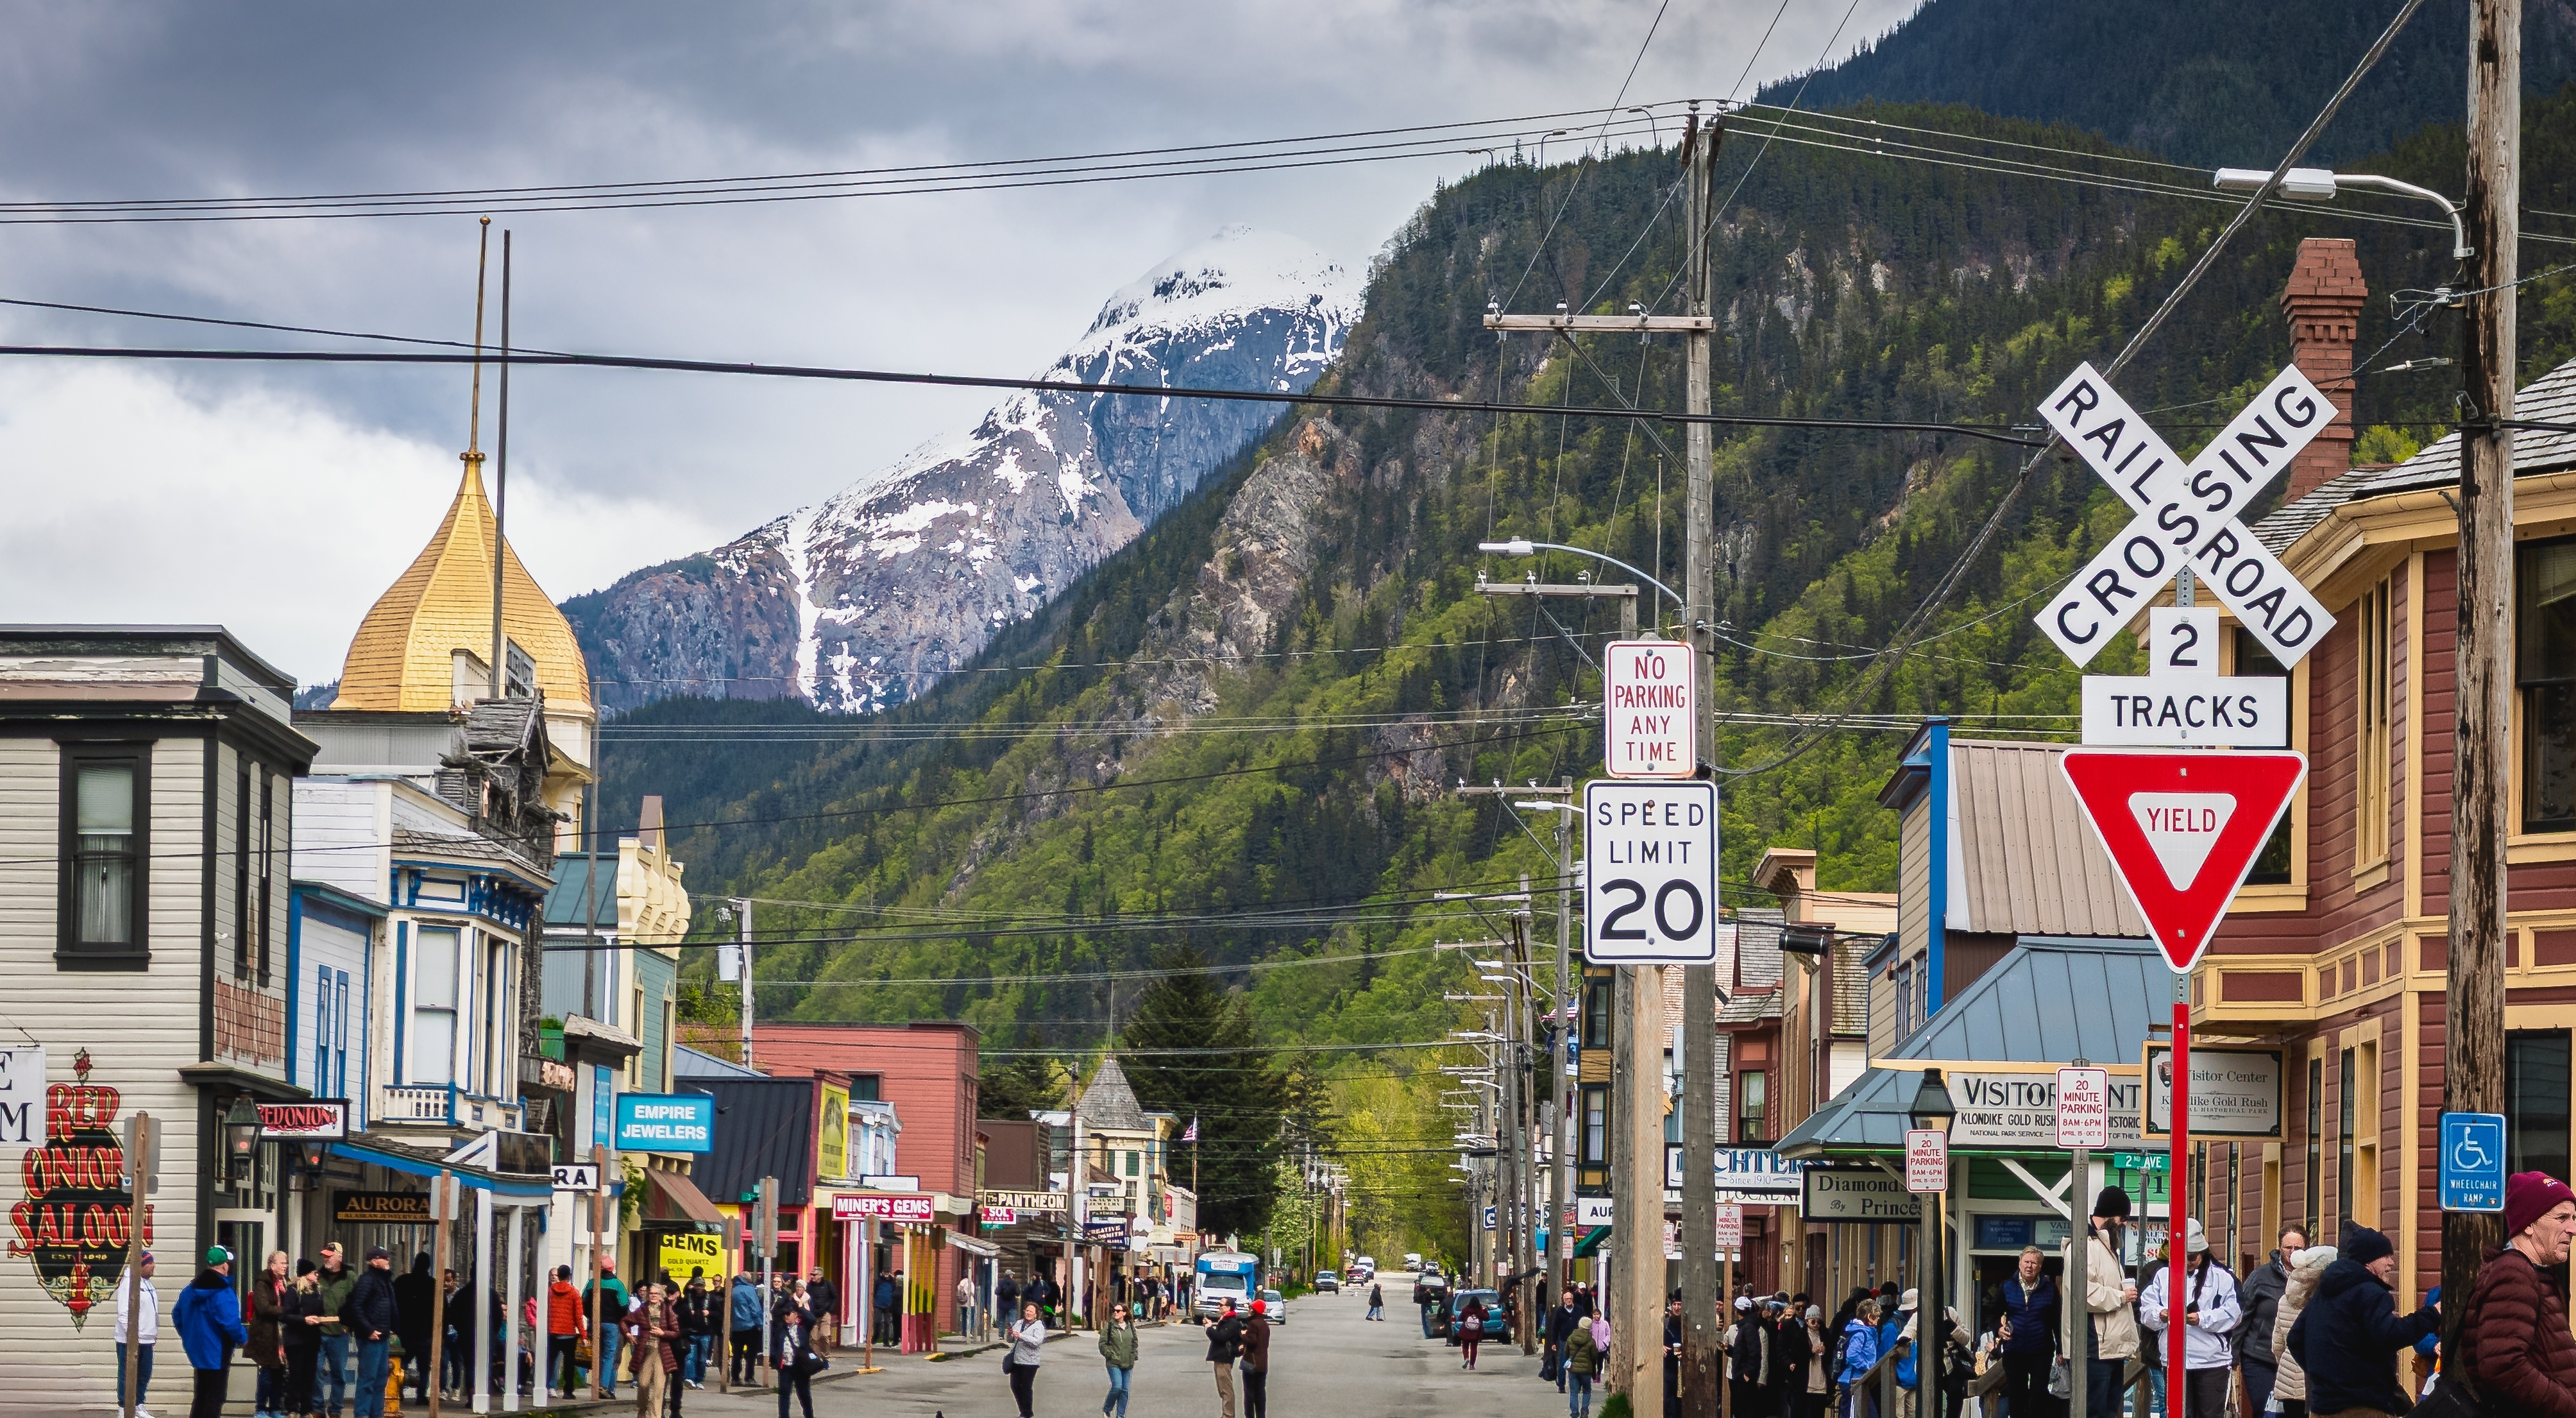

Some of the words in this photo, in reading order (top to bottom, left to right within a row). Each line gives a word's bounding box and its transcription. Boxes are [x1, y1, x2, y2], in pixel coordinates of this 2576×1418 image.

[2055, 379, 2164, 505] RAIL
[2196, 527, 2312, 647] ROAD
[2057, 386, 2317, 644] CROSSING
[2169, 623, 2198, 666] 2
[1635, 656, 1665, 679] NO
[1615, 685, 1685, 708] PARKING
[2110, 695, 2258, 728] TRACKS
[1631, 715, 1670, 735] ANY
[1625, 742, 1677, 761] TIME
[1598, 802, 1704, 826] SPEED
[2147, 808, 2216, 832] YIELD
[1609, 841, 1691, 864] LIMIT
[1600, 878, 1704, 941] 20
[2189, 1070, 2223, 1082] isitor
[2226, 1070, 2268, 1082] Center
[1963, 1078, 2056, 1107] VISITOR
[2076, 1080, 2089, 1090] 20
[2064, 1092, 2099, 1102] MINUTE
[2161, 1095, 2209, 1106] Kike
[2212, 1096, 2237, 1107] Gold
[2241, 1097, 2268, 1107] Rush
[46, 1083, 120, 1142] RED
[284, 1106, 330, 1127] ONION
[634, 1105, 695, 1120] EMPIRE
[2061, 1104, 2103, 1114] PARKING
[1962, 1113, 2003, 1125] KLONDIKE
[2008, 1114, 2031, 1126] GOLD
[2035, 1114, 2056, 1127] RUSH
[622, 1124, 707, 1140] JEWELERS
[2144, 1156, 2162, 1168] AVE
[1729, 1175, 1751, 1184] Since
[1754, 1175, 1770, 1184] 1910
[2450, 1179, 2497, 1190] WHEELCHAIR
[346, 1197, 430, 1211] AURORA
[837, 1198, 890, 1213] MINER'S
[894, 1199, 930, 1214] GEMS
[998, 1193, 1065, 1208] PANTHEON
[1830, 1199, 1846, 1212] By
[2464, 1193, 2484, 1203] RAMP
[662, 1234, 717, 1256] GEMS
